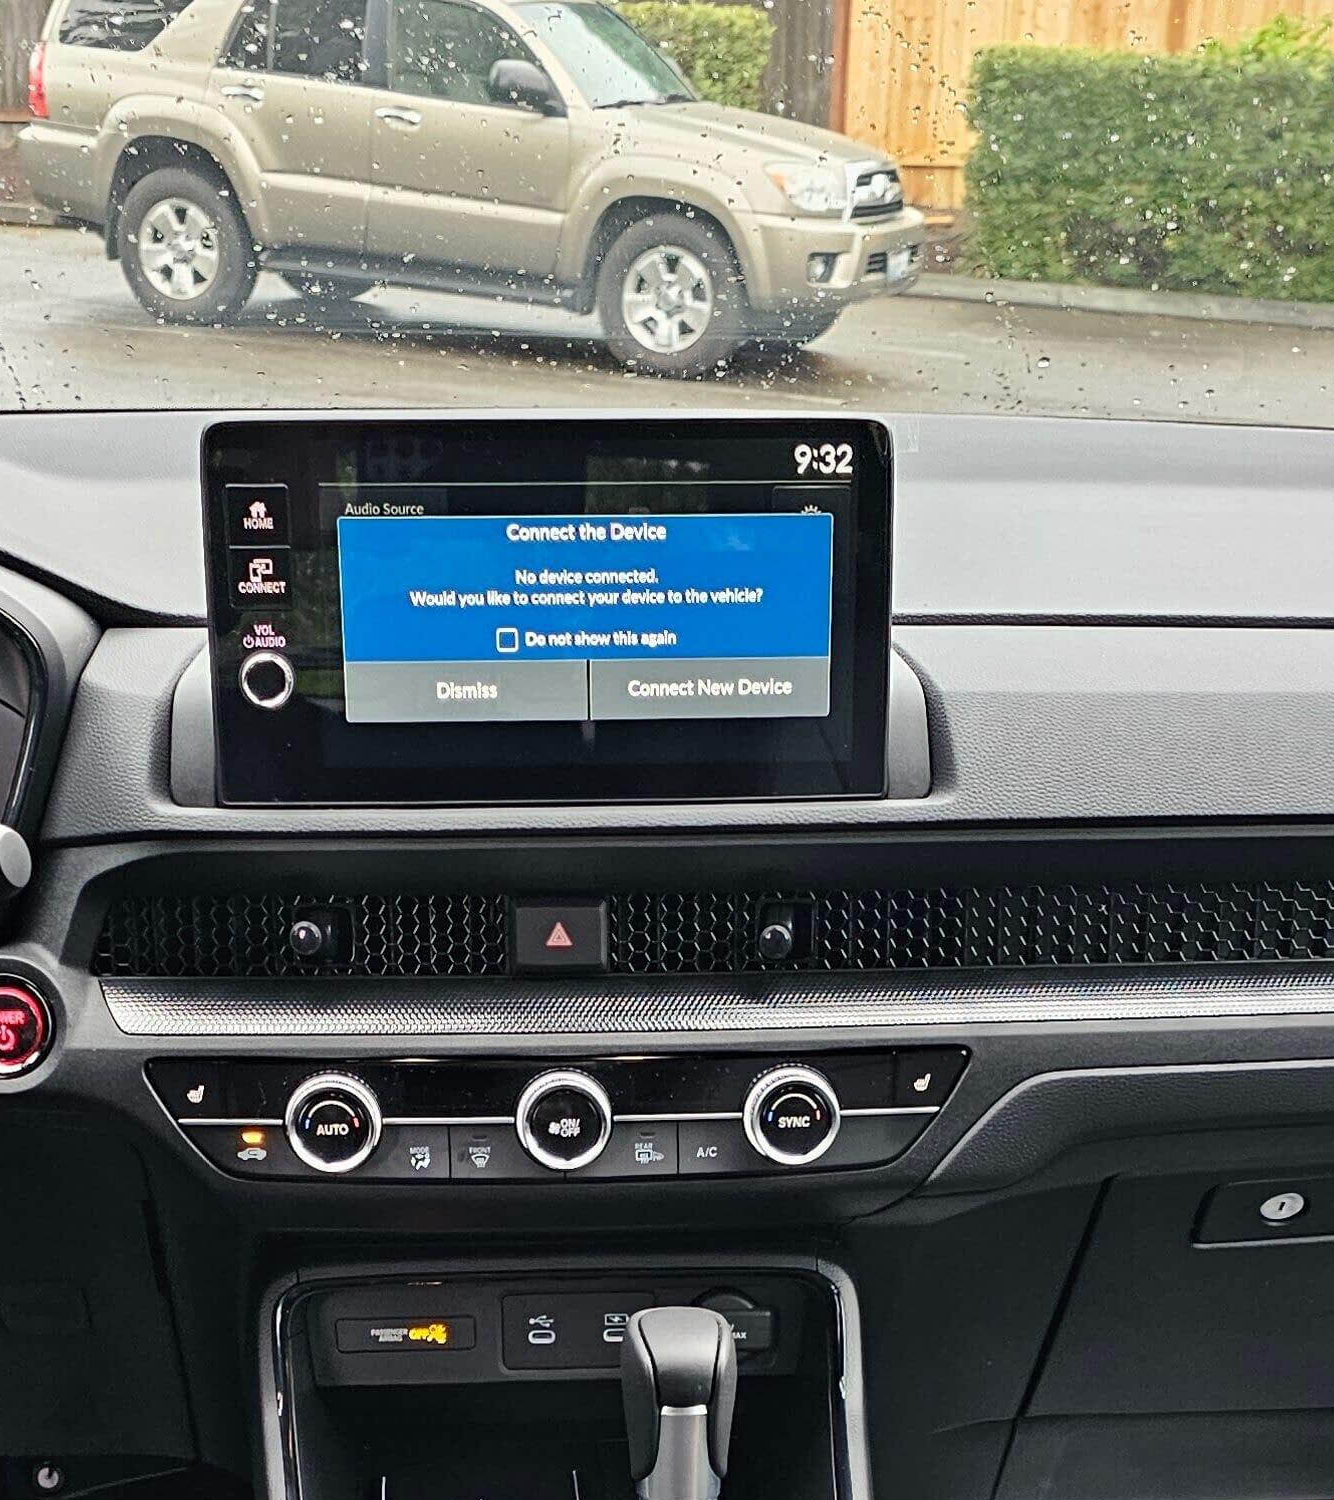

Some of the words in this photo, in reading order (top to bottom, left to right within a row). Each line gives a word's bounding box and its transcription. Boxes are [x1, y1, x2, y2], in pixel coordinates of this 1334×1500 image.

[794, 443, 854, 475] 9:32
[344, 503, 381, 515] Audio
[383, 503, 425, 515] Source
[243, 517, 274, 530] HOME
[505, 523, 577, 541] Connect
[578, 522, 607, 541] the
[610, 522, 667, 541] Device
[515, 569, 537, 585] No
[538, 569, 583, 585] device
[584, 568, 659, 584] connected.
[238, 581, 287, 594] CONNECT
[409, 590, 456, 607] Would
[457, 593, 485, 609] you
[487, 590, 511, 606] like
[513, 591, 529, 606] to
[530, 590, 585, 606] connect
[586, 592, 620, 608] your
[621, 588, 666, 605] device
[667, 589, 683, 604] to
[685, 588, 709, 604] the
[709, 587, 764, 604] vehicle?
[253, 624, 275, 637] VOL
[255, 636, 287, 648] AUDIO
[524, 631, 547, 647] Do
[548, 631, 573, 646] not
[574, 630, 612, 646] show
[612, 630, 639, 646] this
[640, 629, 678, 648] again
[436, 681, 498, 700] Dismiss
[627, 679, 695, 698] Connect
[697, 678, 735, 697] New
[737, 677, 793, 696] Device
[777, 1115, 811, 1129] SYNC
[316, 1122, 349, 1137] AUTO
[560, 1127, 581, 1138] OFF
[409, 1146, 430, 1155] MODE
[468, 1146, 491, 1154] FRONT
[696, 1146, 718, 1159] A/C
